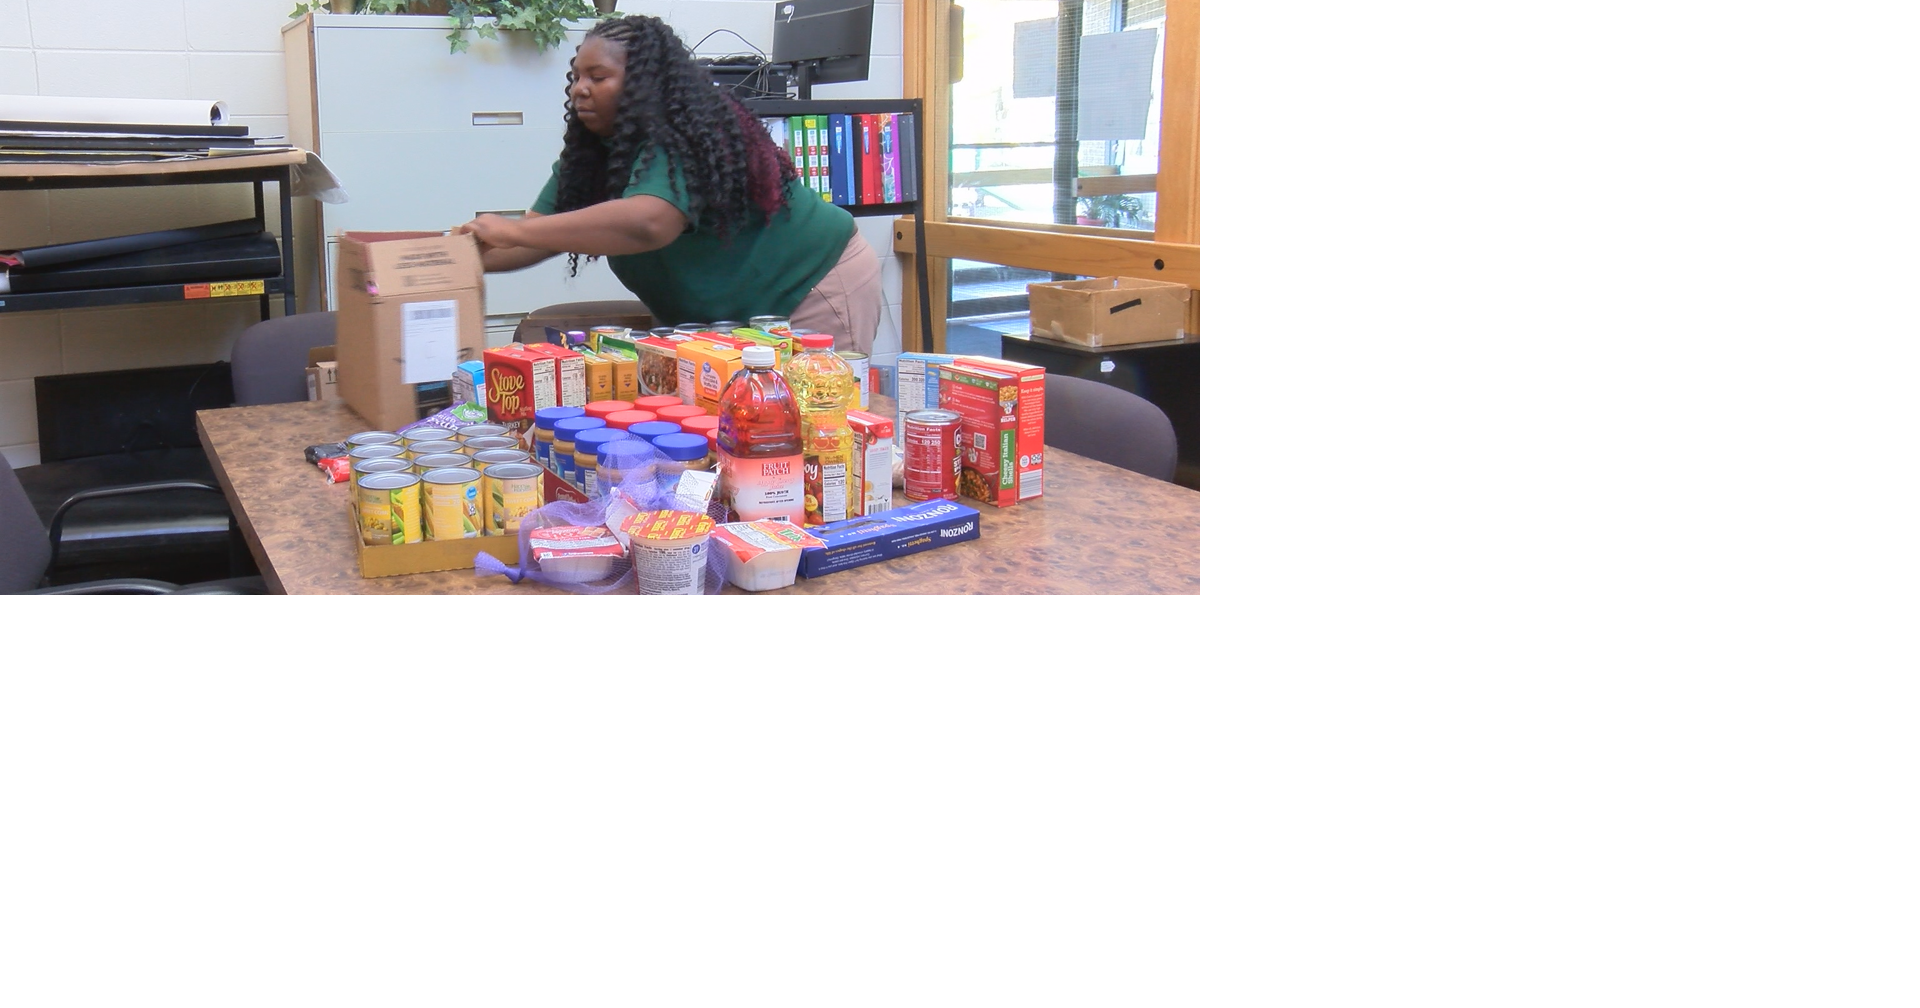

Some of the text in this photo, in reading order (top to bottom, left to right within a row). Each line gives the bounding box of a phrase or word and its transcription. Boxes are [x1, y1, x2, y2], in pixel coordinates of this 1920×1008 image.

[488, 368, 524, 403] Stove
[499, 391, 521, 415] Top
[763, 468, 789, 476] PATCH
[804, 463, 818, 480] oy
[891, 504, 958, 522] RONZONI
[940, 521, 974, 538] RONZONI
